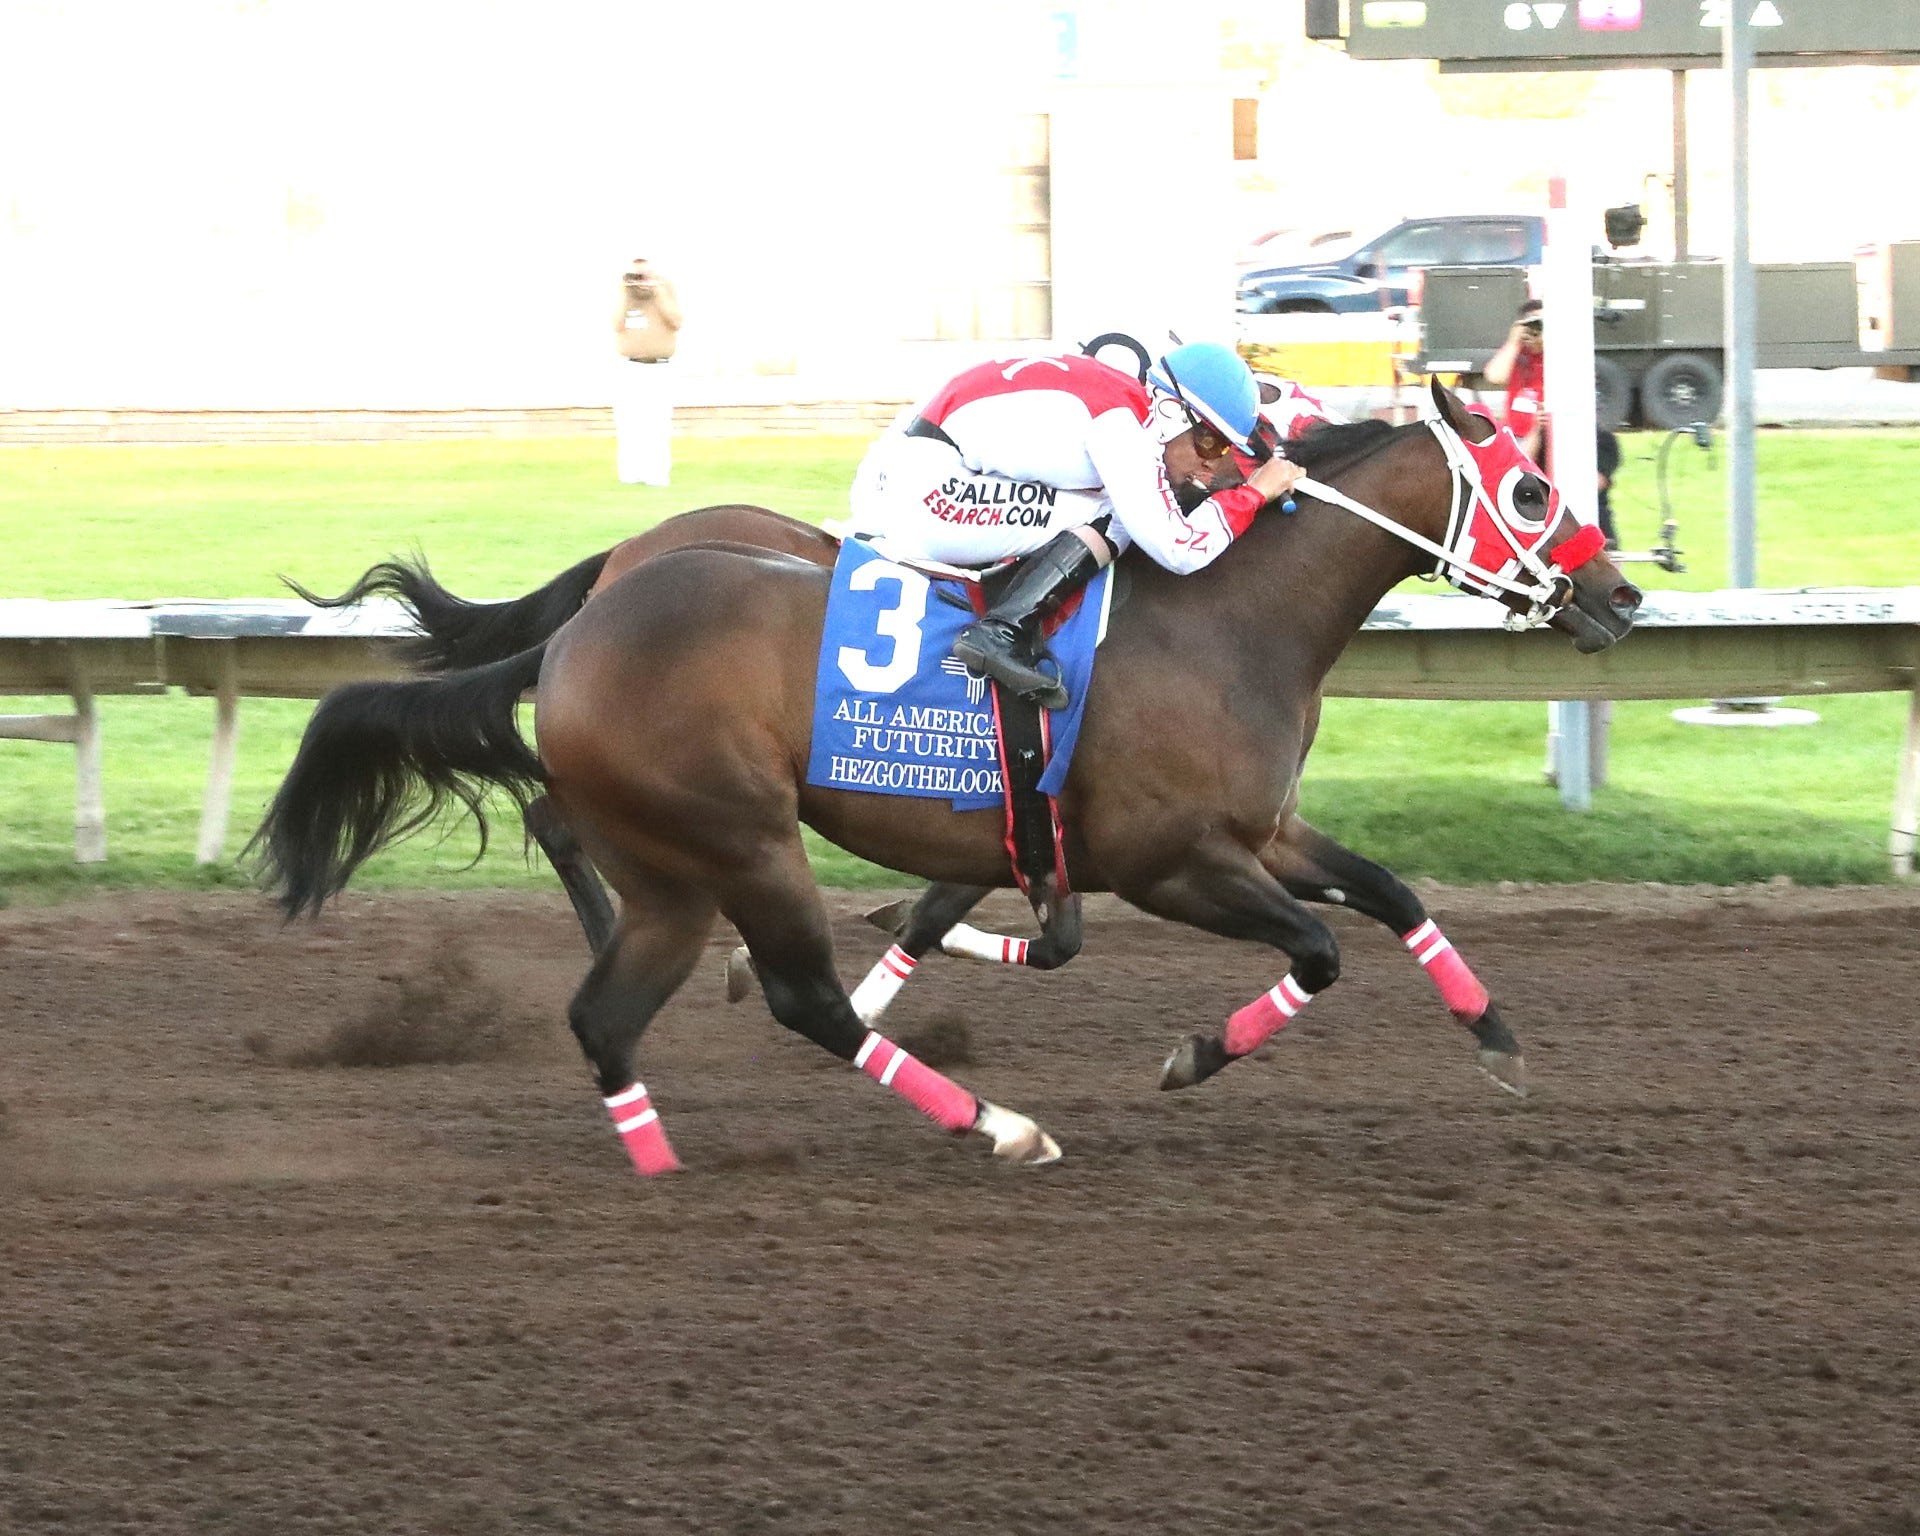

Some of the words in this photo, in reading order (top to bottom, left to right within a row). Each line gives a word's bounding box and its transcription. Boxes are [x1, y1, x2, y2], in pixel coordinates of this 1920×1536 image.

[837, 558, 931, 694] 3
[832, 698, 885, 726] ALL
[852, 725, 1000, 761] FUTURITY
[829, 755, 1006, 794] HEZGOTHELOOK
